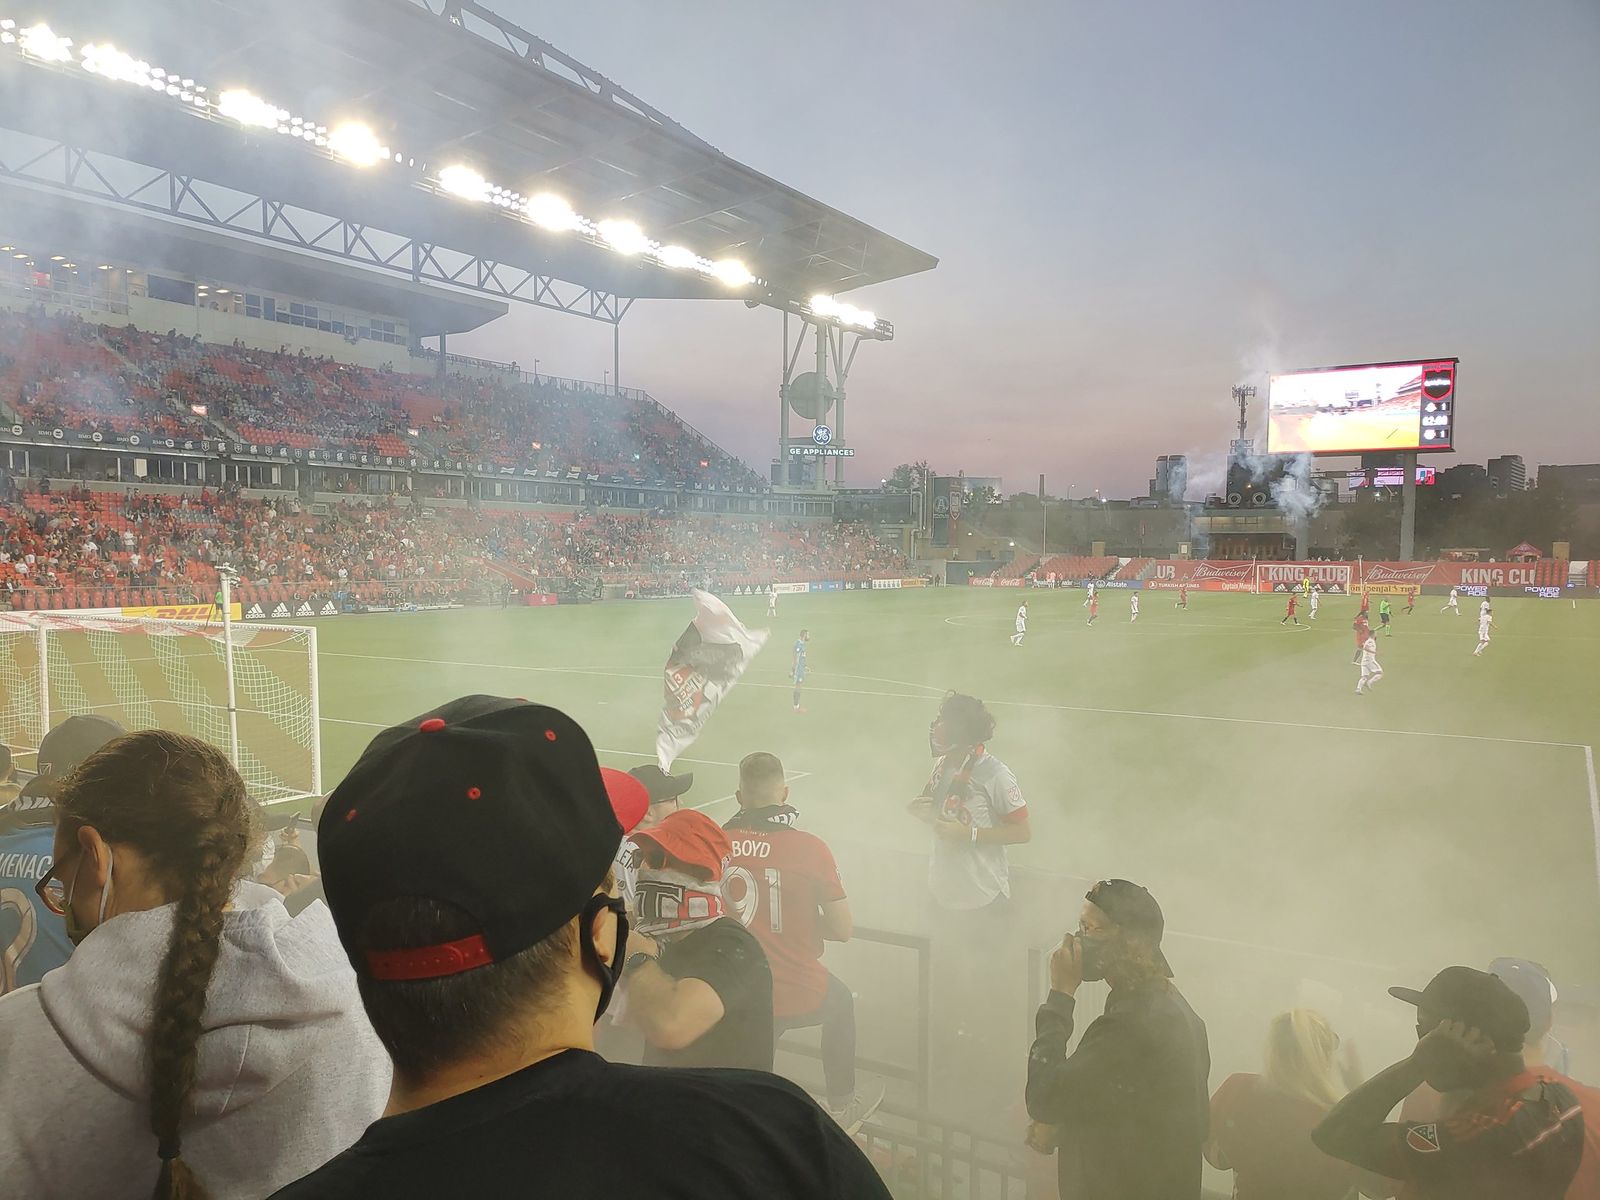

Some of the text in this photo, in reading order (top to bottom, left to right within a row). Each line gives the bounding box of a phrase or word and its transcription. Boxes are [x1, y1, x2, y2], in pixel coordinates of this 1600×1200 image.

[803, 448, 854, 456] APPLIANCES
[1195, 567, 1248, 577] Budweiser
[1268, 567, 1347, 581] KING CLUB
[1369, 569, 1429, 580] Budweiser
[1461, 569, 1504, 584] KING
[732, 840, 771, 858] BOYD
[720, 866, 782, 933] 91
